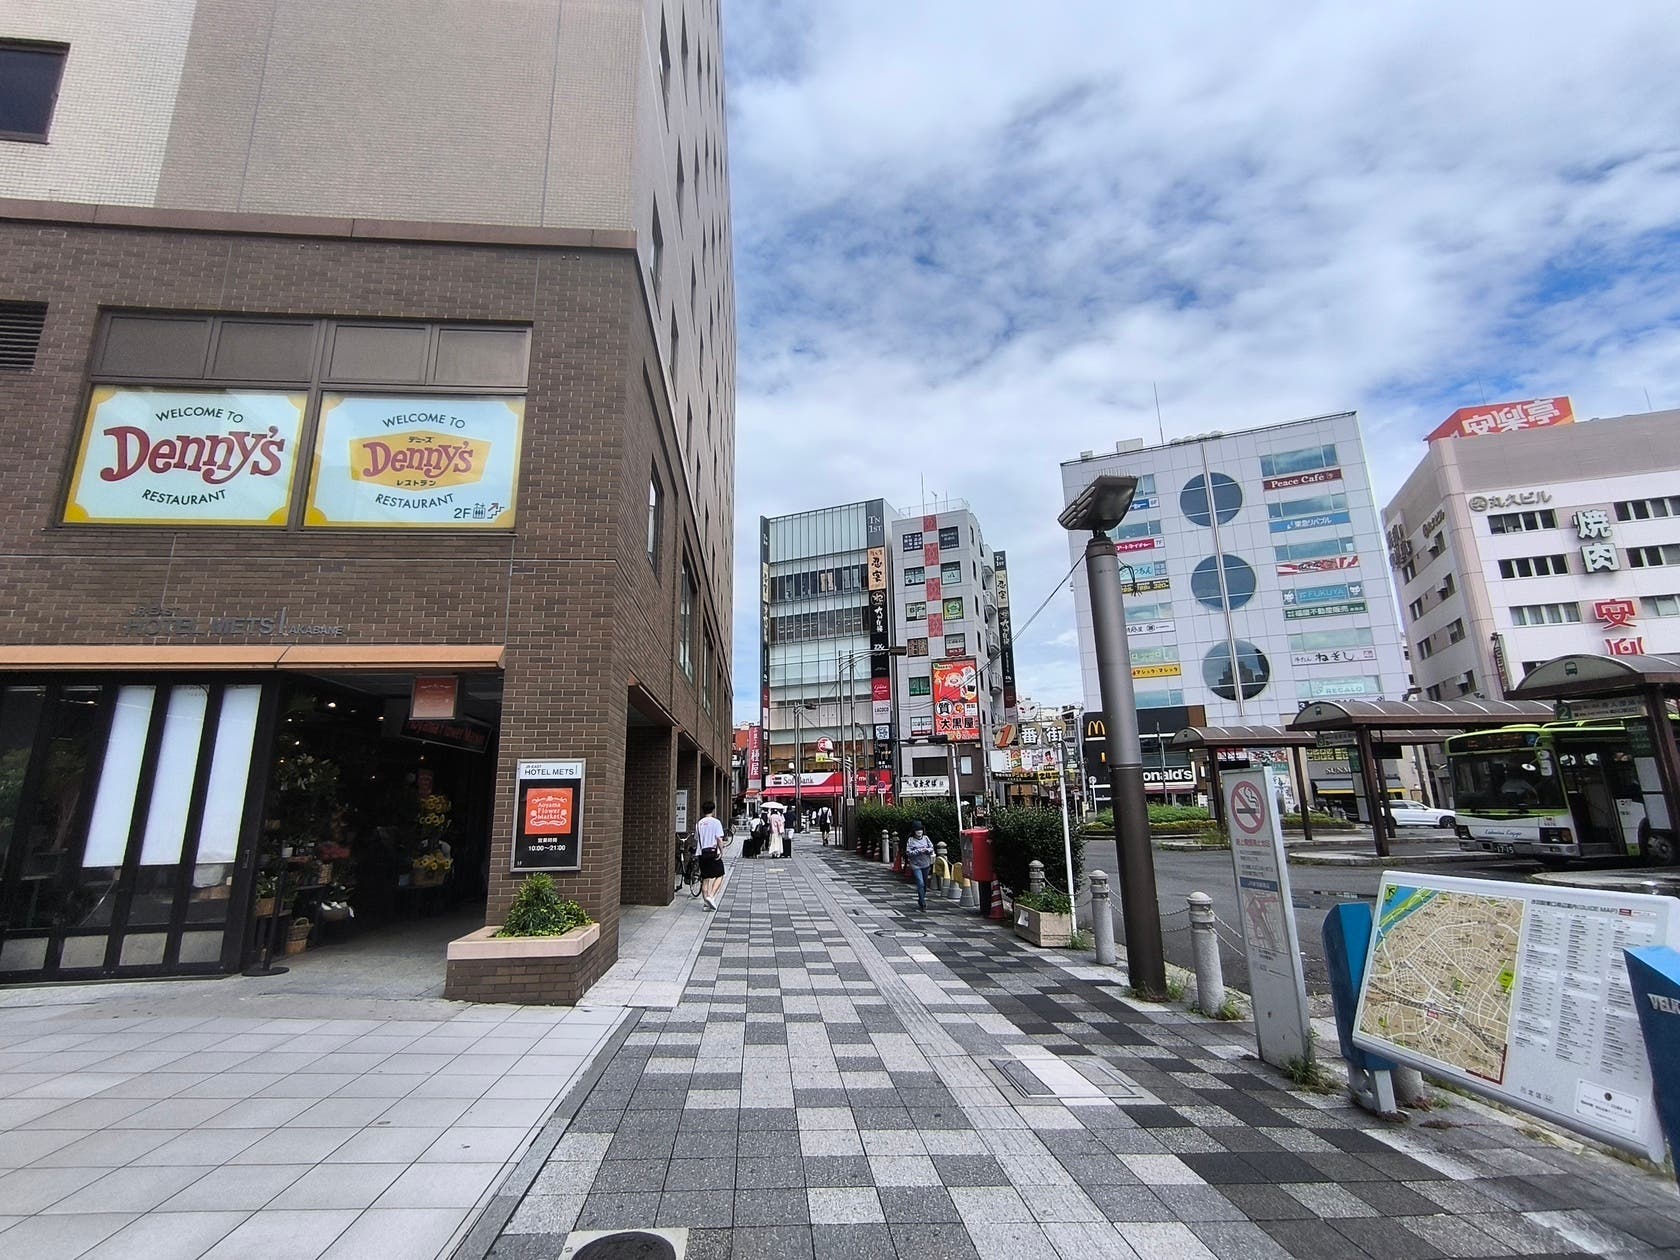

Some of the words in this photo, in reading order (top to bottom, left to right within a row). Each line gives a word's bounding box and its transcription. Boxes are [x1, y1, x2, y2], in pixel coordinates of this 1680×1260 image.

[155, 406, 223, 422] WELCOME
[228, 410, 243, 423] TO
[382, 412, 446, 428] WELCOME
[449, 416, 466, 429] TO
[1462, 399, 1560, 434] 安楽亭
[100, 425, 286, 485] Denny's
[362, 440, 474, 479] Denny's
[396, 479, 437, 487] レストラン
[1271, 478, 1299, 488] Peace
[1301, 473, 1326, 484] Café
[141, 488, 227, 505] RESTAURANT
[375, 492, 454, 509] RESTAURANT
[453, 507, 471, 519] 2F
[1575, 509, 1620, 572] 焼肉
[124, 618, 204, 636] HOTEL
[210, 617, 275, 635] METS
[288, 624, 344, 636] AKABANE
[1315, 650, 1355, 662] ねぎし
[1561, 706, 1569, 719] 2
[940, 716, 975, 729] 大黒屋
[994, 724, 1062, 748] 1番街
[552, 768, 574, 776] METS
[1143, 769, 1193, 781] onald's
